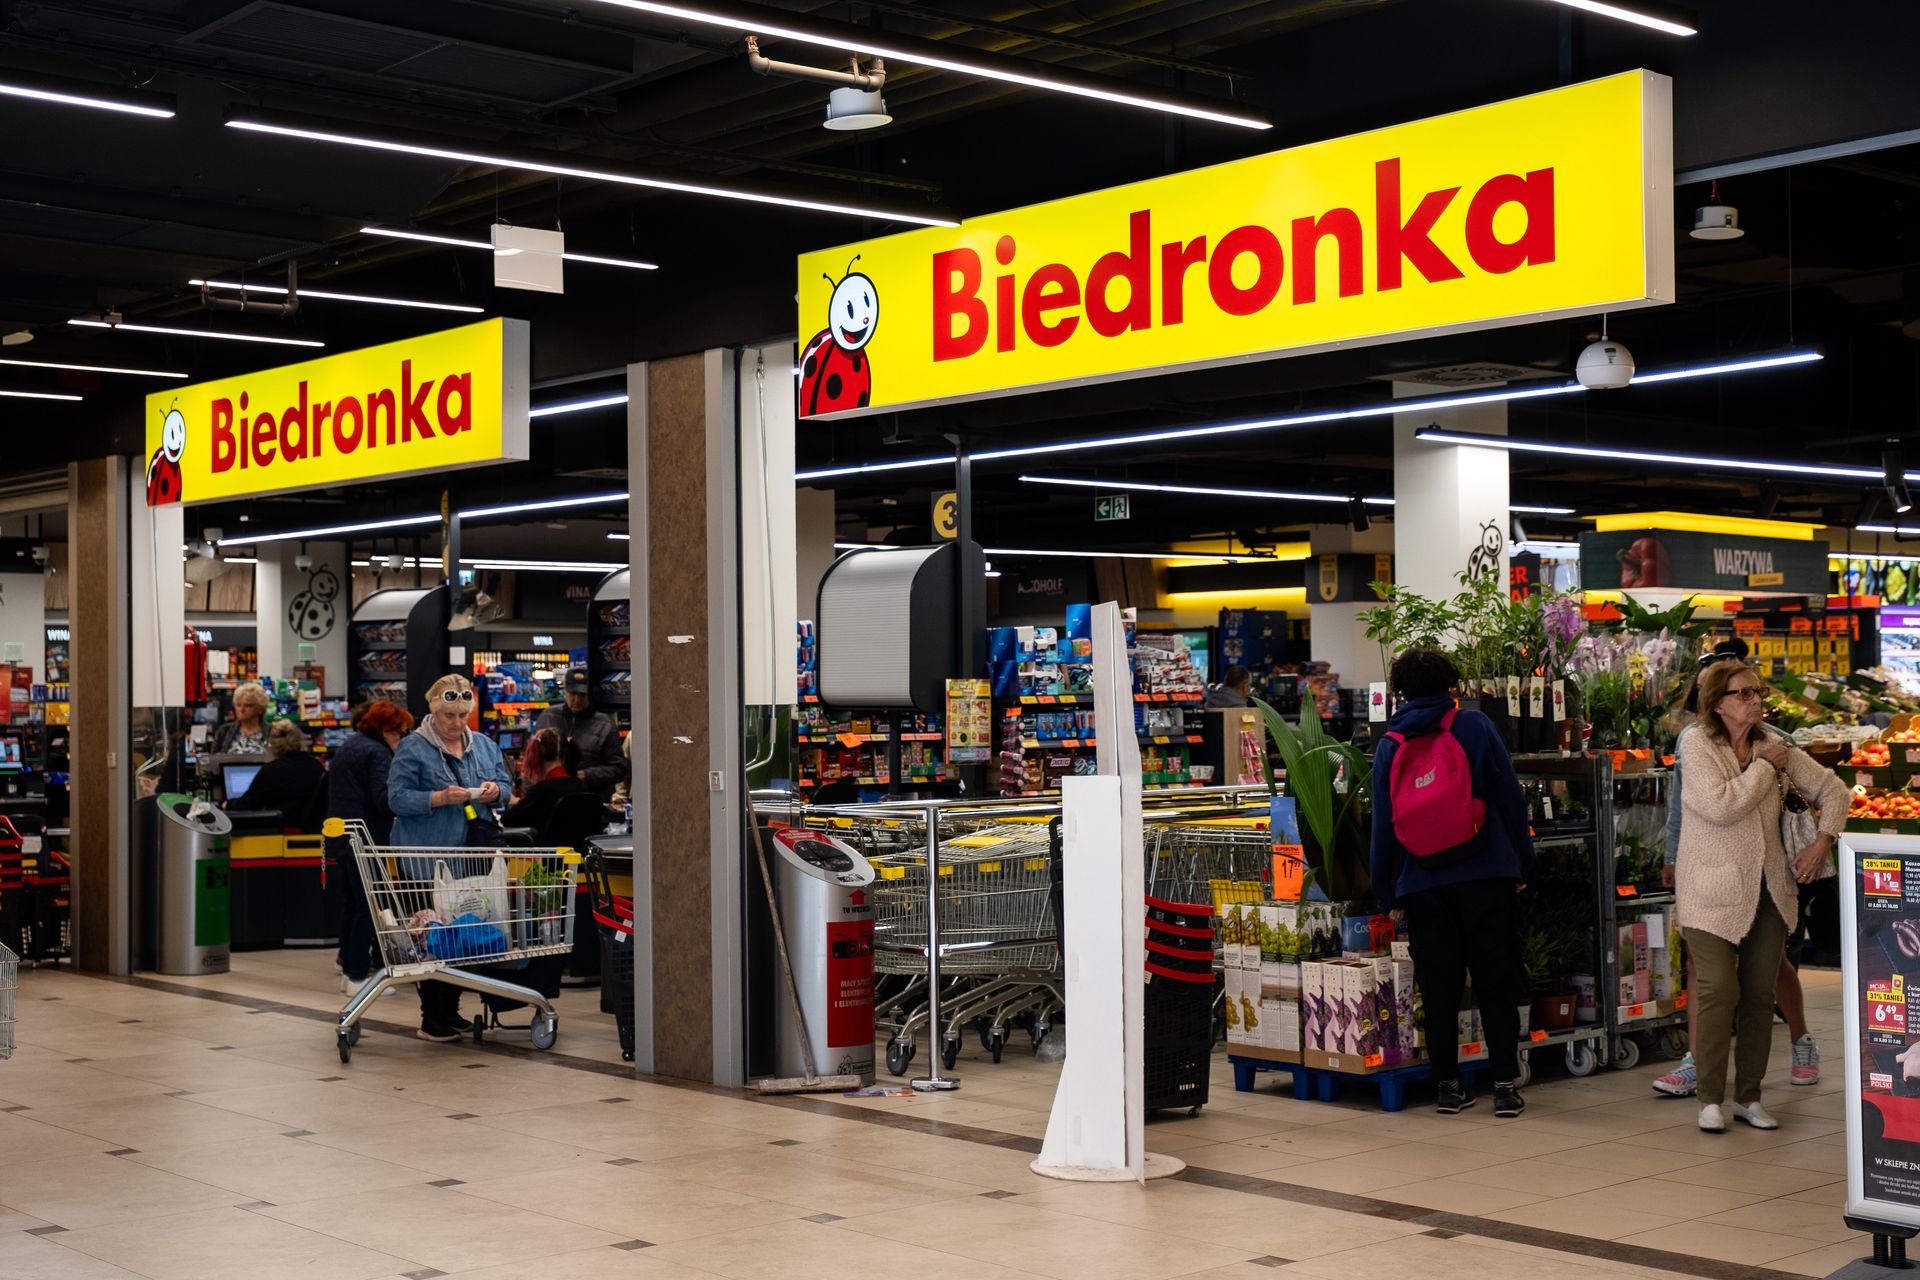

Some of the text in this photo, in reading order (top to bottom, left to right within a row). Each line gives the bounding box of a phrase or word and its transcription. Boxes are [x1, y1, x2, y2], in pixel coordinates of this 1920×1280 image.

[933, 159, 1555, 361] Biedronka
[211, 361, 471, 472] Biedronka
[943, 501, 958, 531] 3
[1714, 549, 1774, 575] WARZYWA
[1018, 578, 1064, 593] AOHOLE
[1415, 766, 1436, 788] CAT
[1282, 859, 1294, 879] 17
[1874, 872, 1881, 890] 1
[1884, 993, 1903, 1002] TANIEJ
[1875, 1004, 1886, 1022] 6
[1885, 1005, 1897, 1014] 49
[1871, 1080, 1892, 1089] POLSKI
[1875, 1157, 1920, 1172] W SKLEPIE ZN
